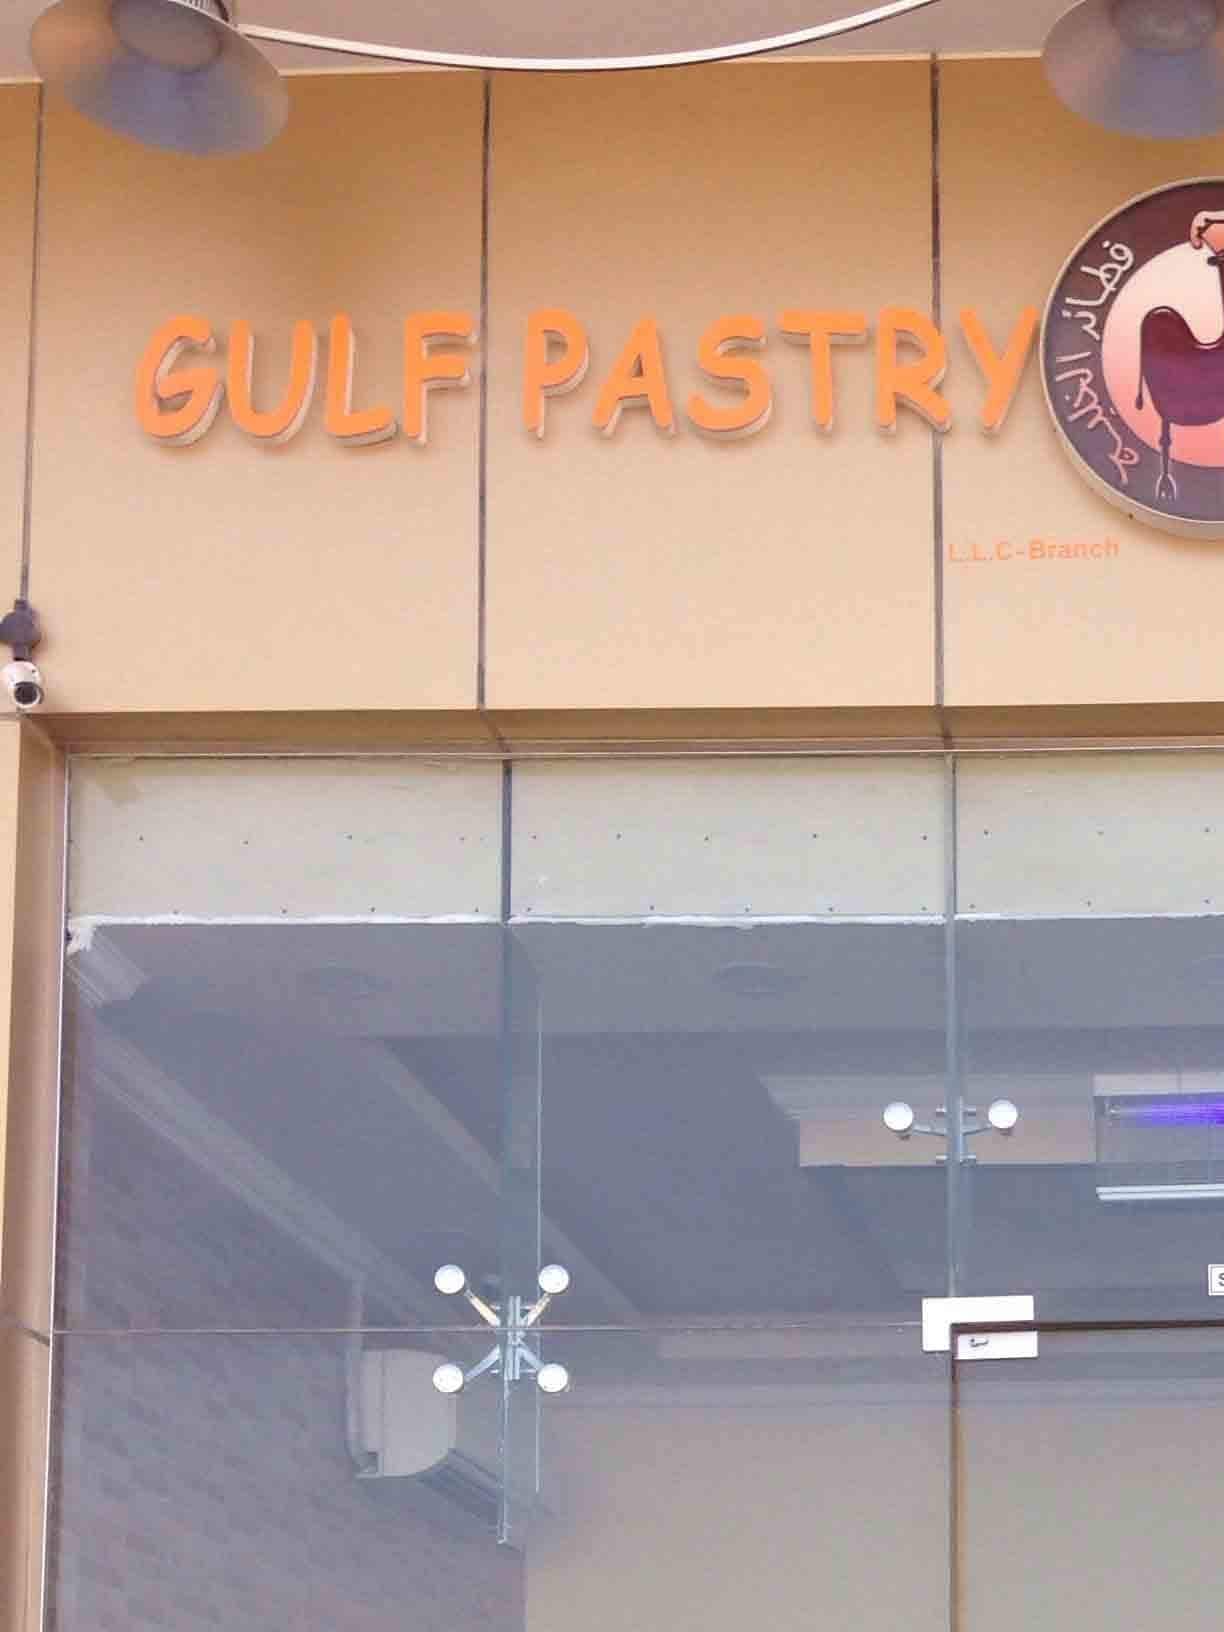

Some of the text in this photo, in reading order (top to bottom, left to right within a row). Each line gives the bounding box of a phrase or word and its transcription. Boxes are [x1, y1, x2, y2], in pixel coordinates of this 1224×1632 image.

[135, 306, 1039, 446] GULF PASTRY
[1055, 239, 1140, 485] فطائر الخليج
